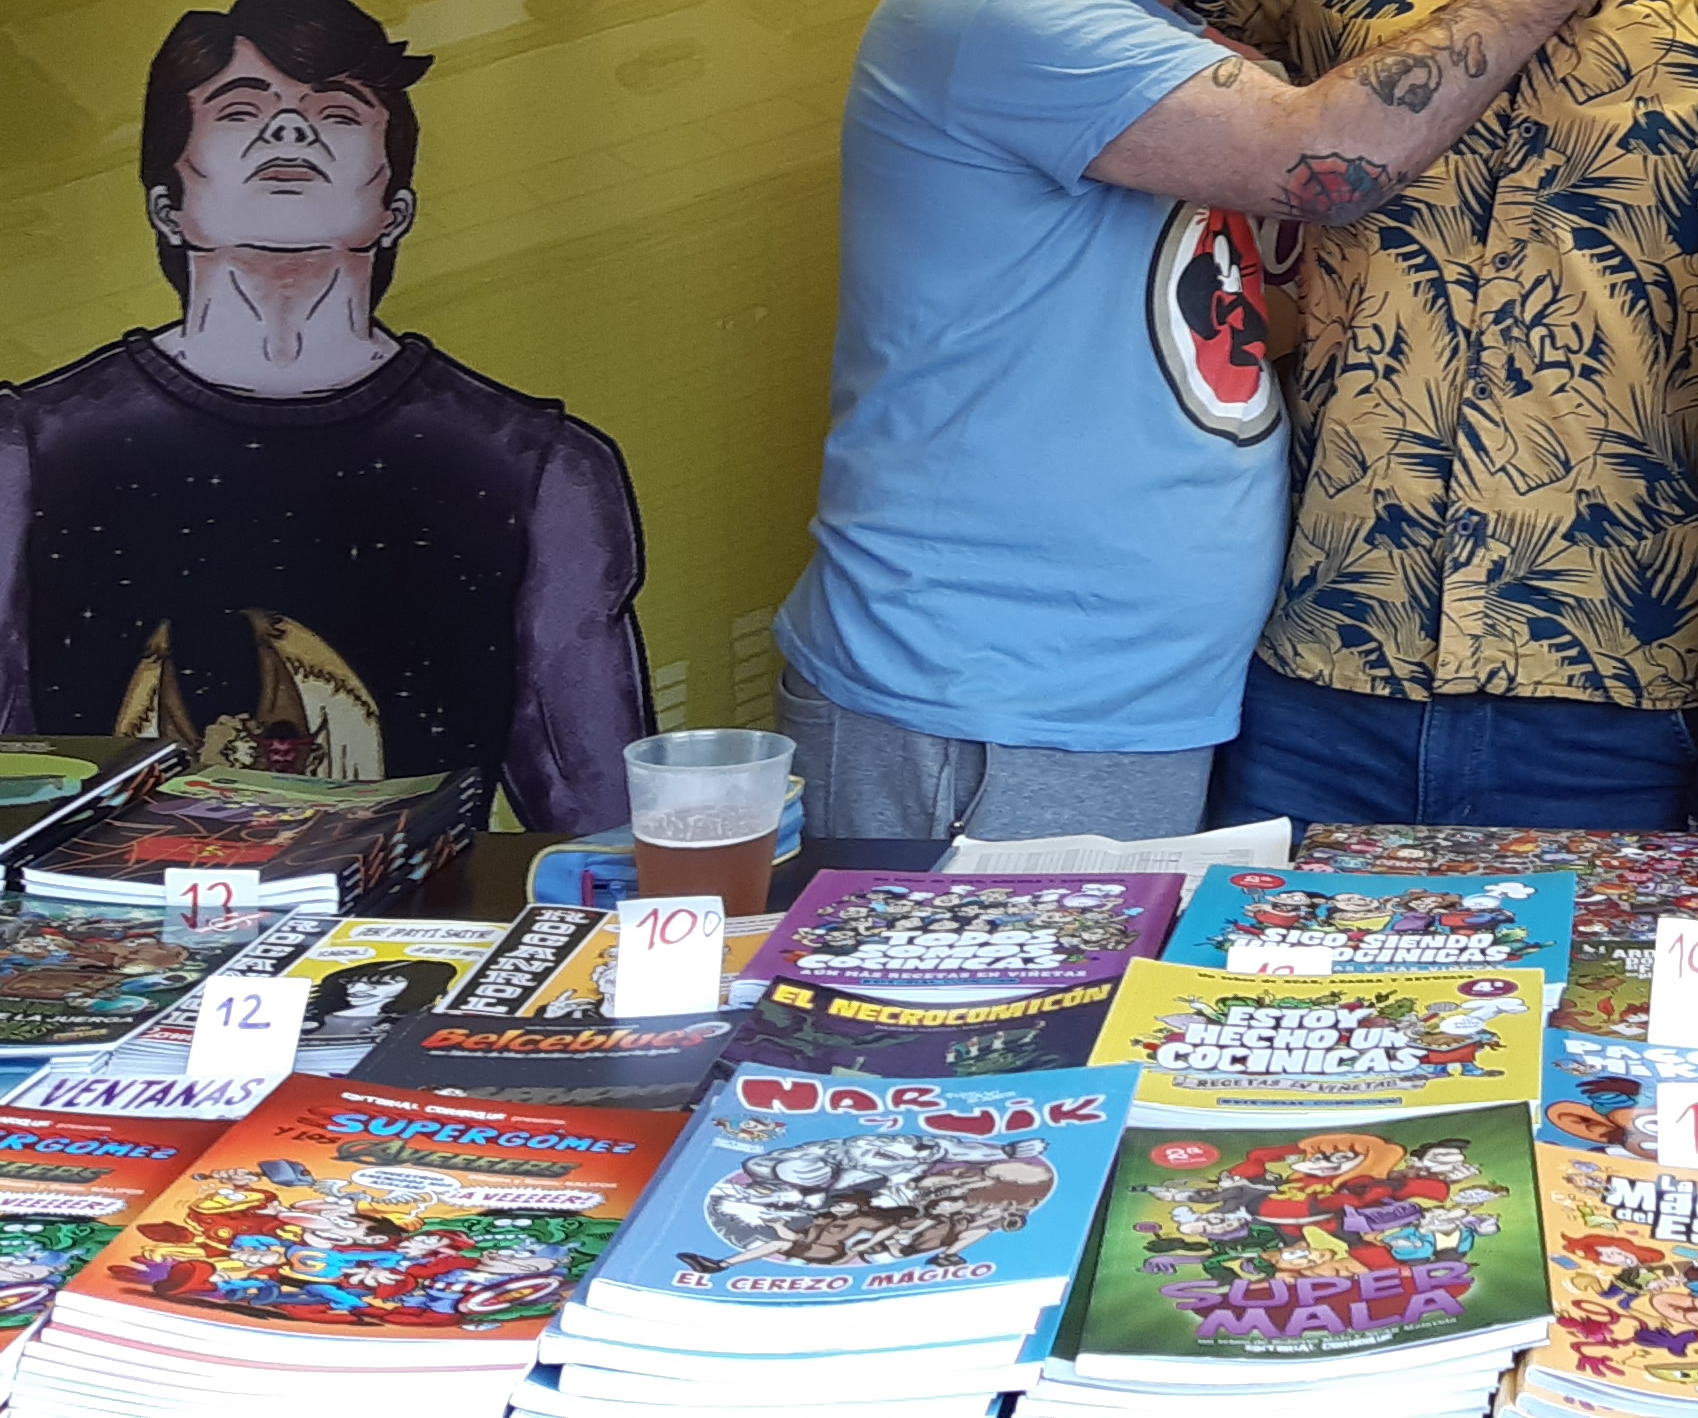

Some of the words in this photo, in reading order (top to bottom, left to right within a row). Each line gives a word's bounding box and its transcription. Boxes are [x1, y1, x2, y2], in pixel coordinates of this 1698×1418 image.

[881, 931, 1057, 947] TODOS
[1263, 928, 1347, 947] SIGO
[1359, 932, 1494, 949] SIENDO
[857, 944, 1055, 960] SOMOS
[1333, 946, 1510, 962] OCINICAS
[880, 970, 970, 980] RECETAS
[975, 970, 1000, 979] EN
[215, 993, 271, 1030] 12
[772, 983, 816, 1010] EL
[828, 983, 1114, 1027] NECROCOMICÓN
[1227, 1007, 1374, 1028] ESTOY
[421, 1028, 706, 1052] Belceblues
[1184, 1025, 1340, 1048] HECHO
[1349, 1028, 1410, 1048] UN
[1157, 1044, 1428, 1072] COCINICAS
[40, 1078, 265, 1111] VENTANAS
[738, 1077, 945, 1114] NAR
[1660, 1176, 1692, 1193] La
[1616, 1210, 1654, 1224] del
[673, 1271, 713, 1288] EL
[729, 1275, 852, 1292] CEREZO
[1160, 1261, 1474, 1310] SUPER
[1196, 1288, 1466, 1338] MALA
